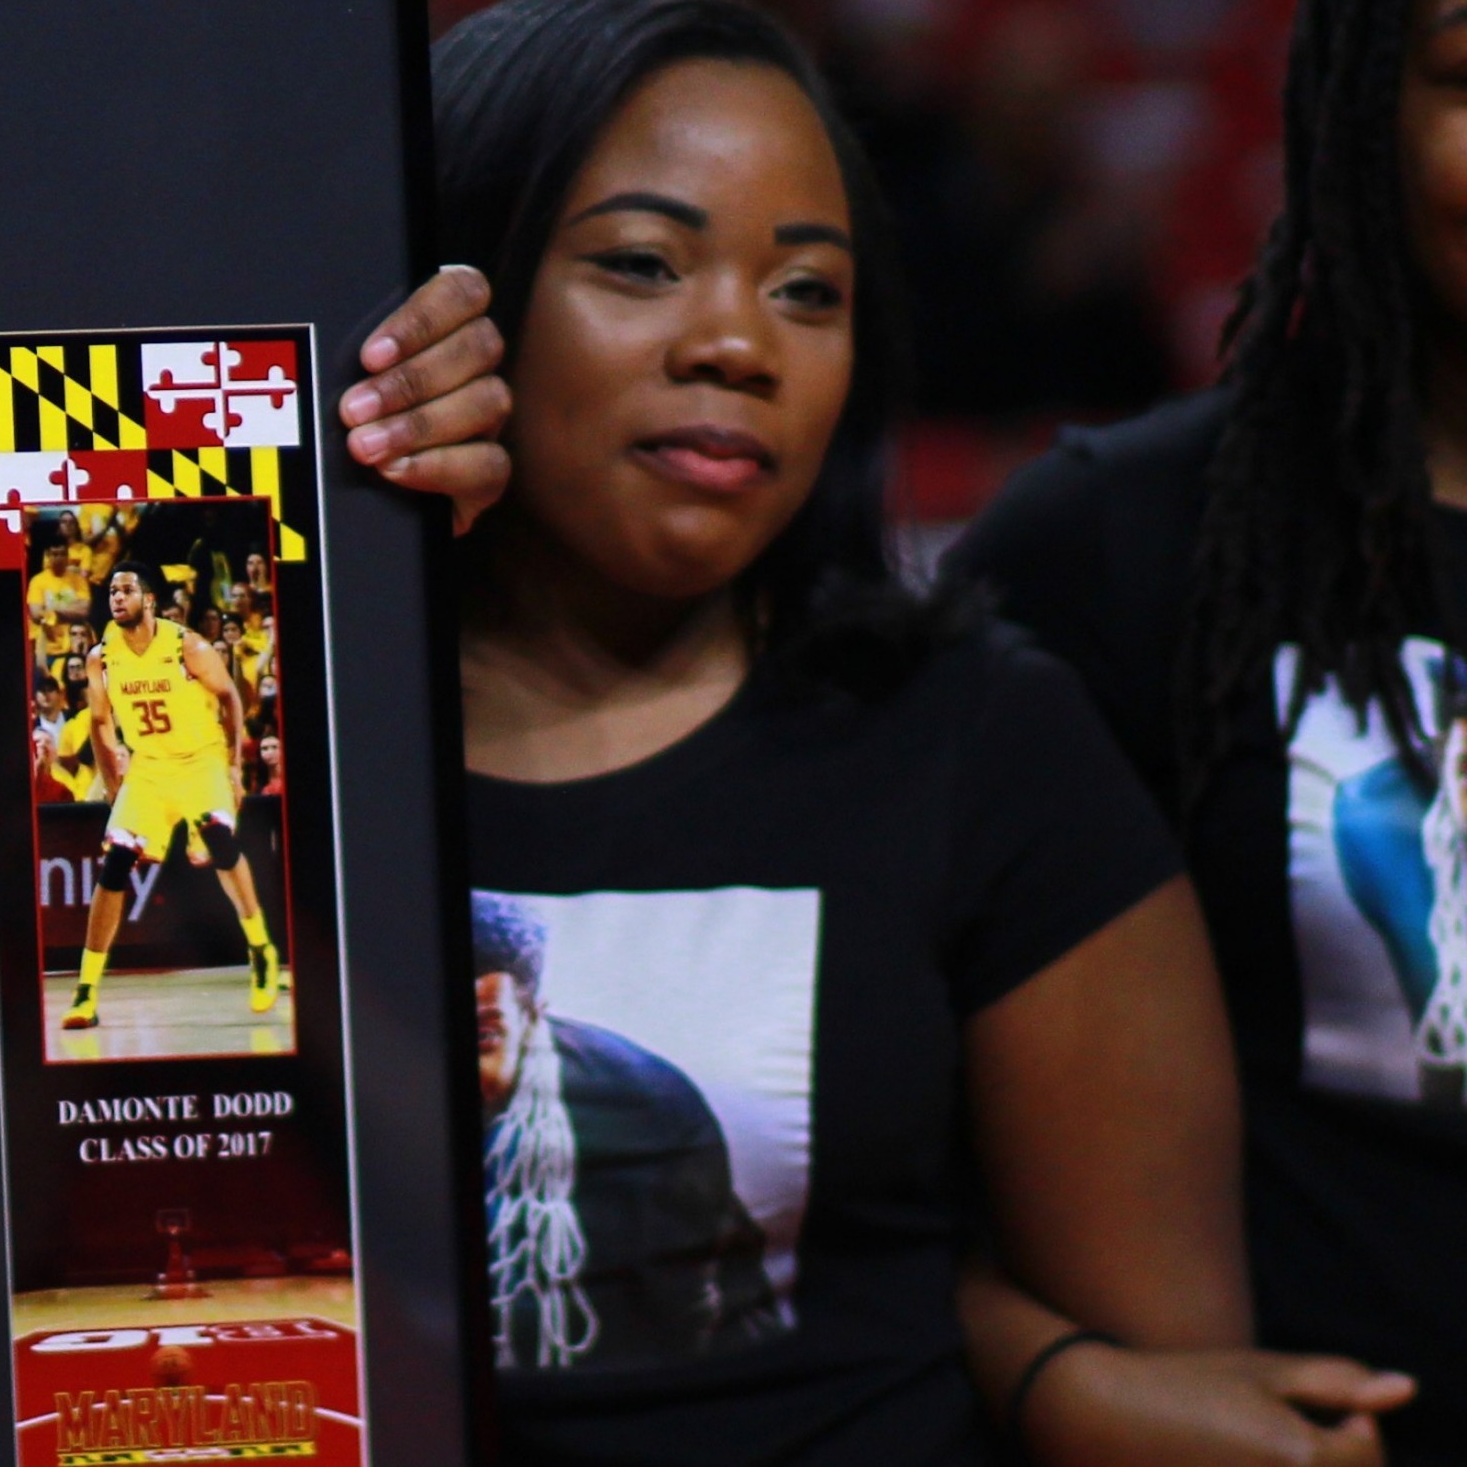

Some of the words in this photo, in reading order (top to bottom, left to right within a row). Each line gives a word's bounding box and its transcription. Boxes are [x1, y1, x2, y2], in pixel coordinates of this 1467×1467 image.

[120, 679, 172, 695] MARYLAND
[132, 700, 172, 737] 35
[57, 1094, 199, 1125] DAMONTE
[213, 1091, 294, 1117] DODD
[78, 1134, 169, 1163] CLASS
[173, 1133, 211, 1159] OF
[217, 1131, 272, 1158] 2017
[54, 1380, 318, 1453] MARYLAND
